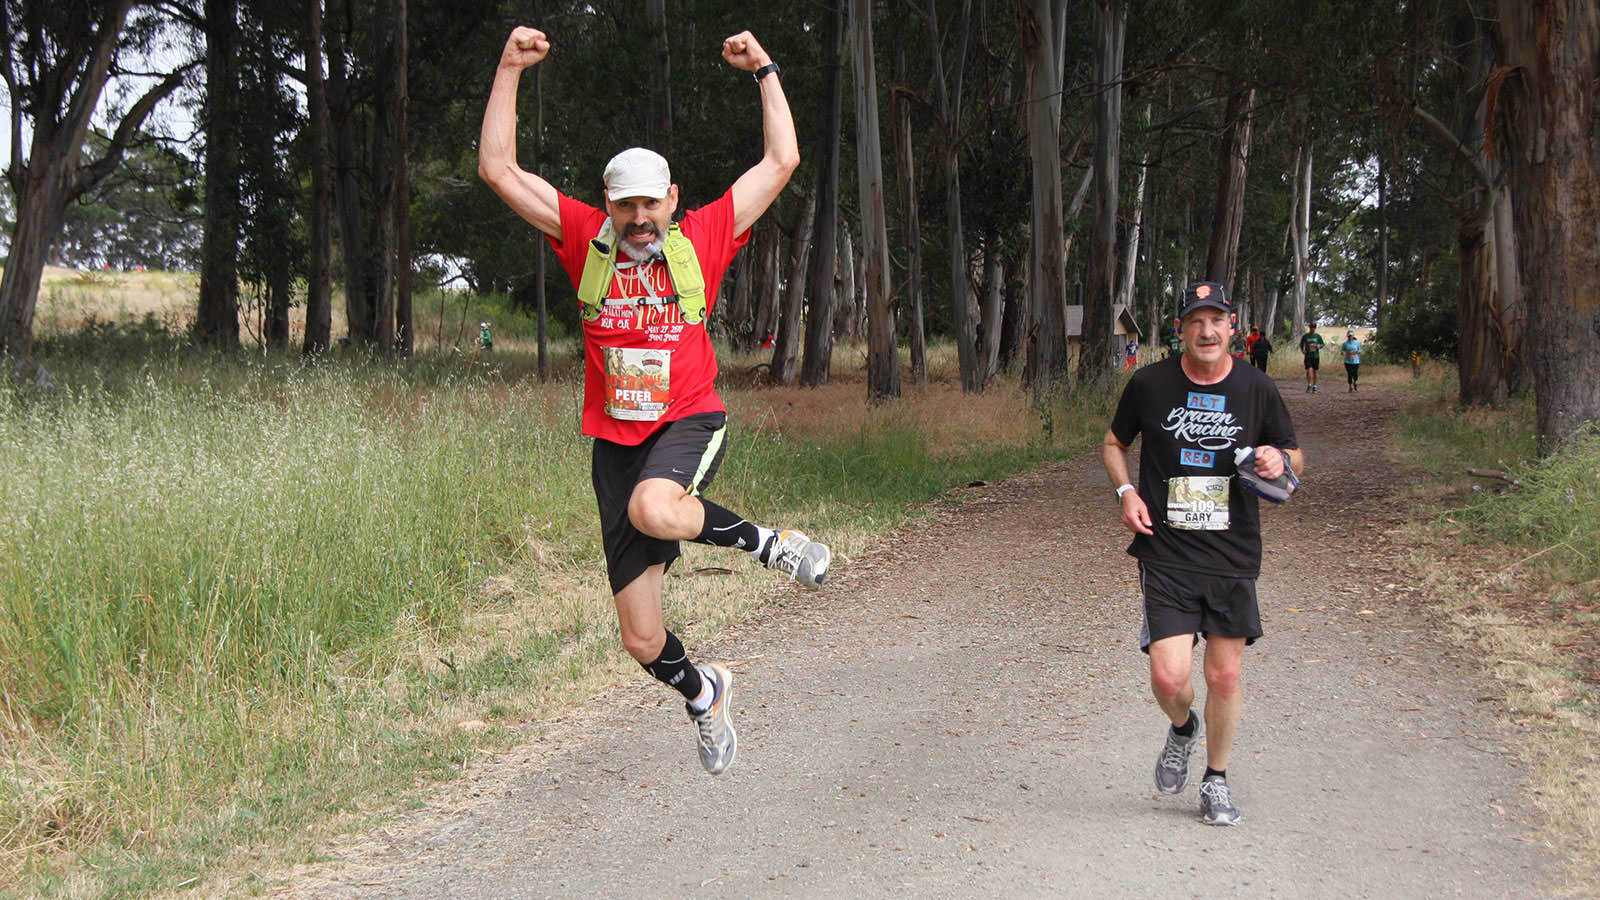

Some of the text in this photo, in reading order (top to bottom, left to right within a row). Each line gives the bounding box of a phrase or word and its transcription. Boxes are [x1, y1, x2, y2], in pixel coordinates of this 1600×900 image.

[615, 389, 651, 402] PETER
[1190, 396, 1219, 408] ALT
[1161, 407, 1237, 431] Brazen
[1174, 421, 1243, 450] Racing
[1183, 451, 1211, 464] RED
[1191, 500, 1215, 512] 109
[1185, 512, 1212, 522] GARY
